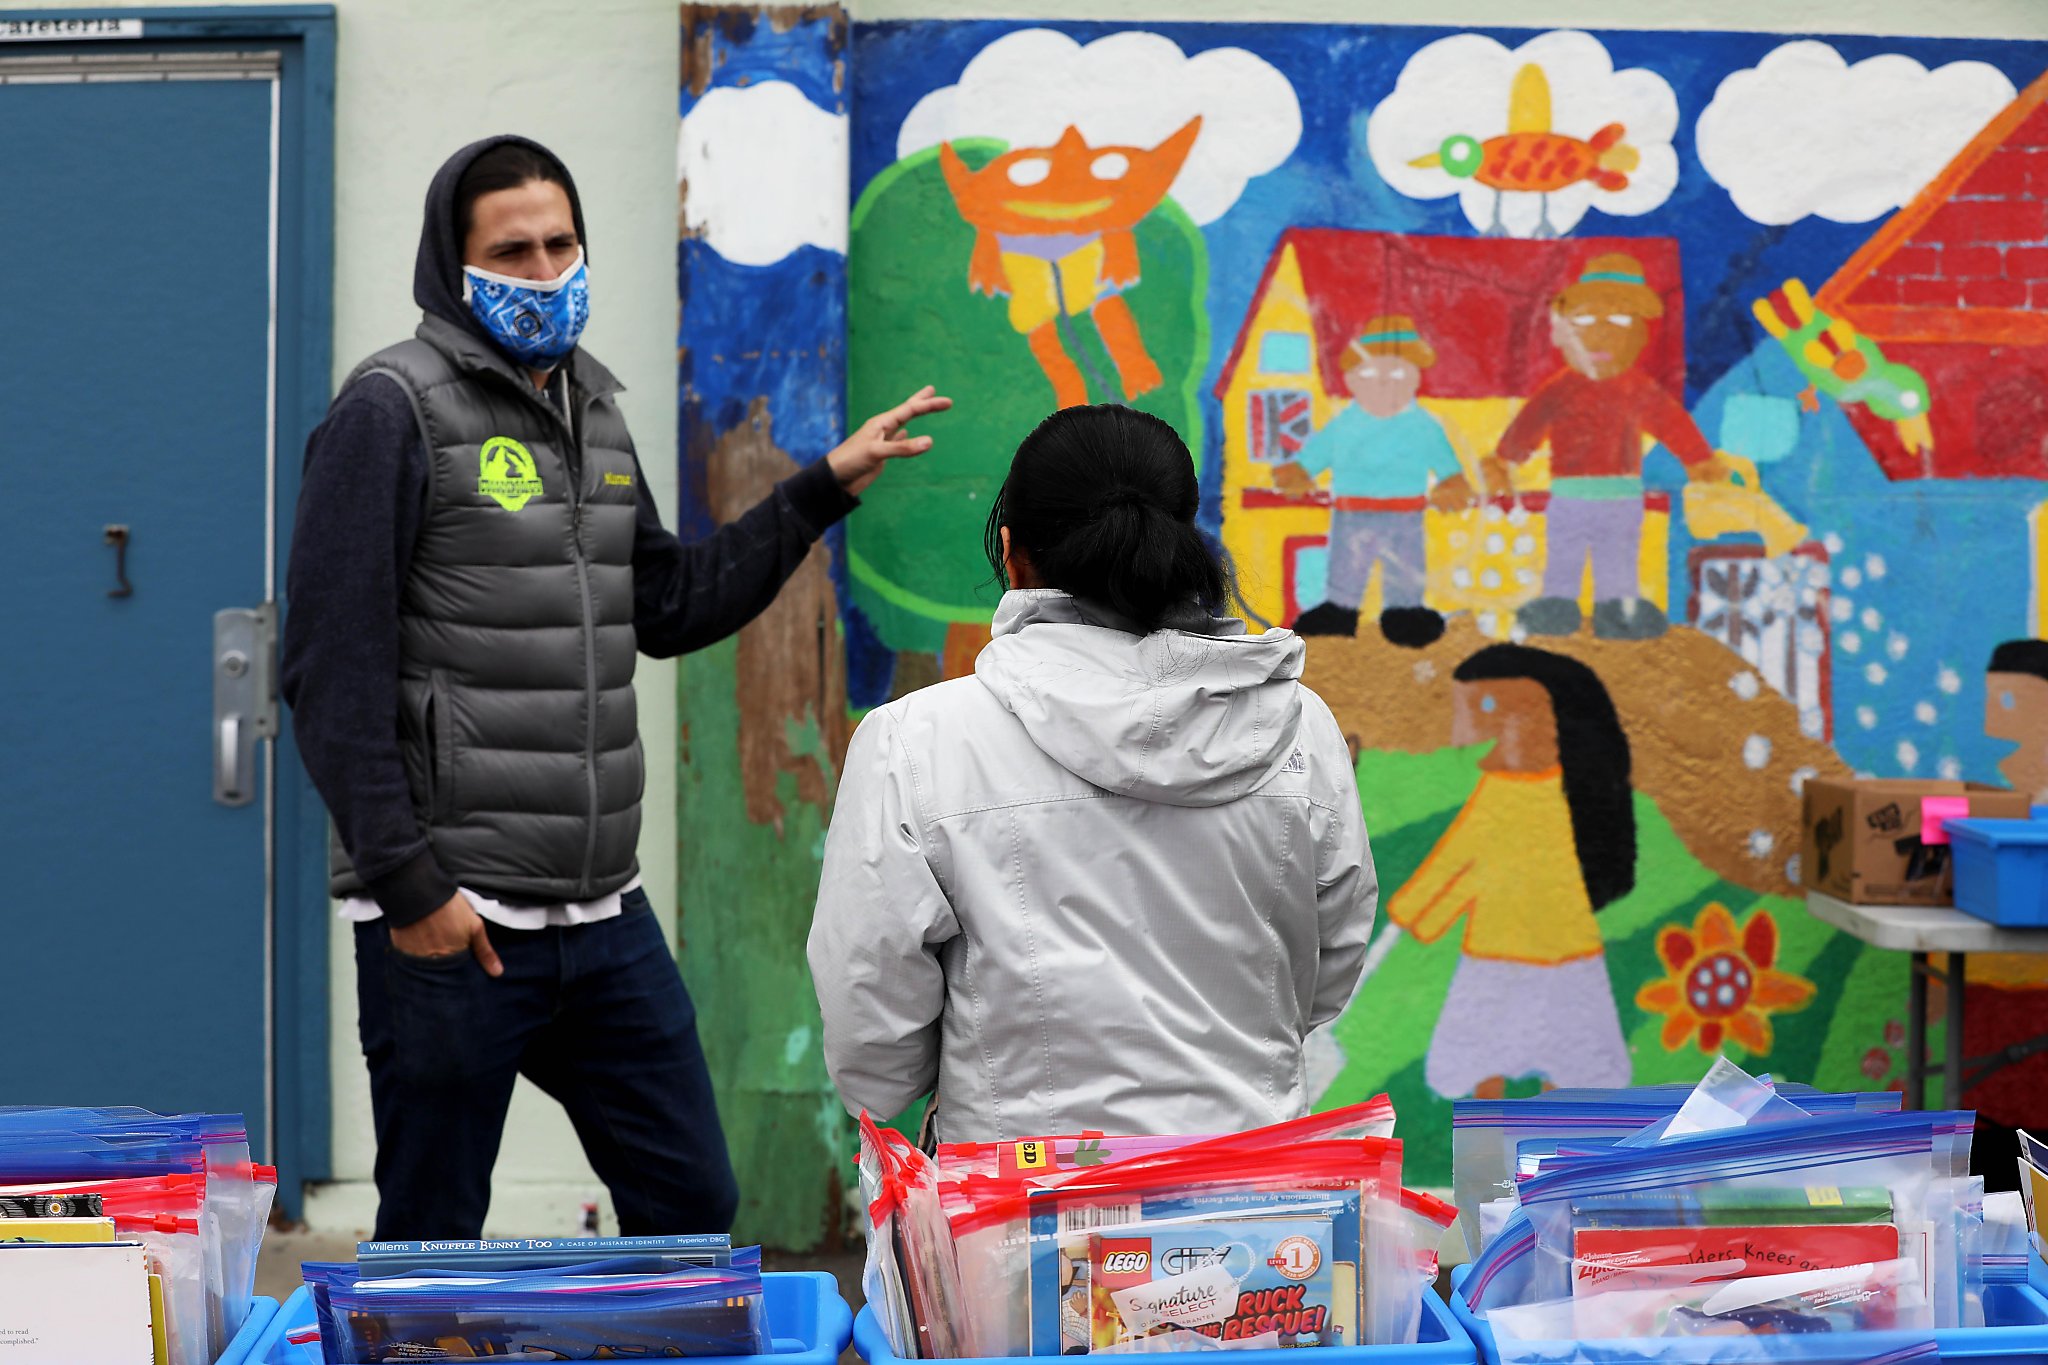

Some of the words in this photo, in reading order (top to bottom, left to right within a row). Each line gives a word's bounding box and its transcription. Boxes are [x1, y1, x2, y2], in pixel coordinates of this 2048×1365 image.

[0, 18, 120, 33] afeteria
[1321, 1208, 1344, 1216] Closed
[369, 1243, 409, 1251] Willems
[420, 1241, 476, 1251] KNUFFLE
[479, 1240, 521, 1251] BUNNY
[525, 1239, 553, 1249] TOO
[677, 1237, 707, 1245] Hyperion
[1744, 1243, 1795, 1266] Knees
[1104, 1252, 1148, 1272] LEGO
[1290, 1247, 1304, 1269] 1
[1129, 1285, 1219, 1314] Sgnature
[1223, 1305, 1326, 1341] RESCUE!
